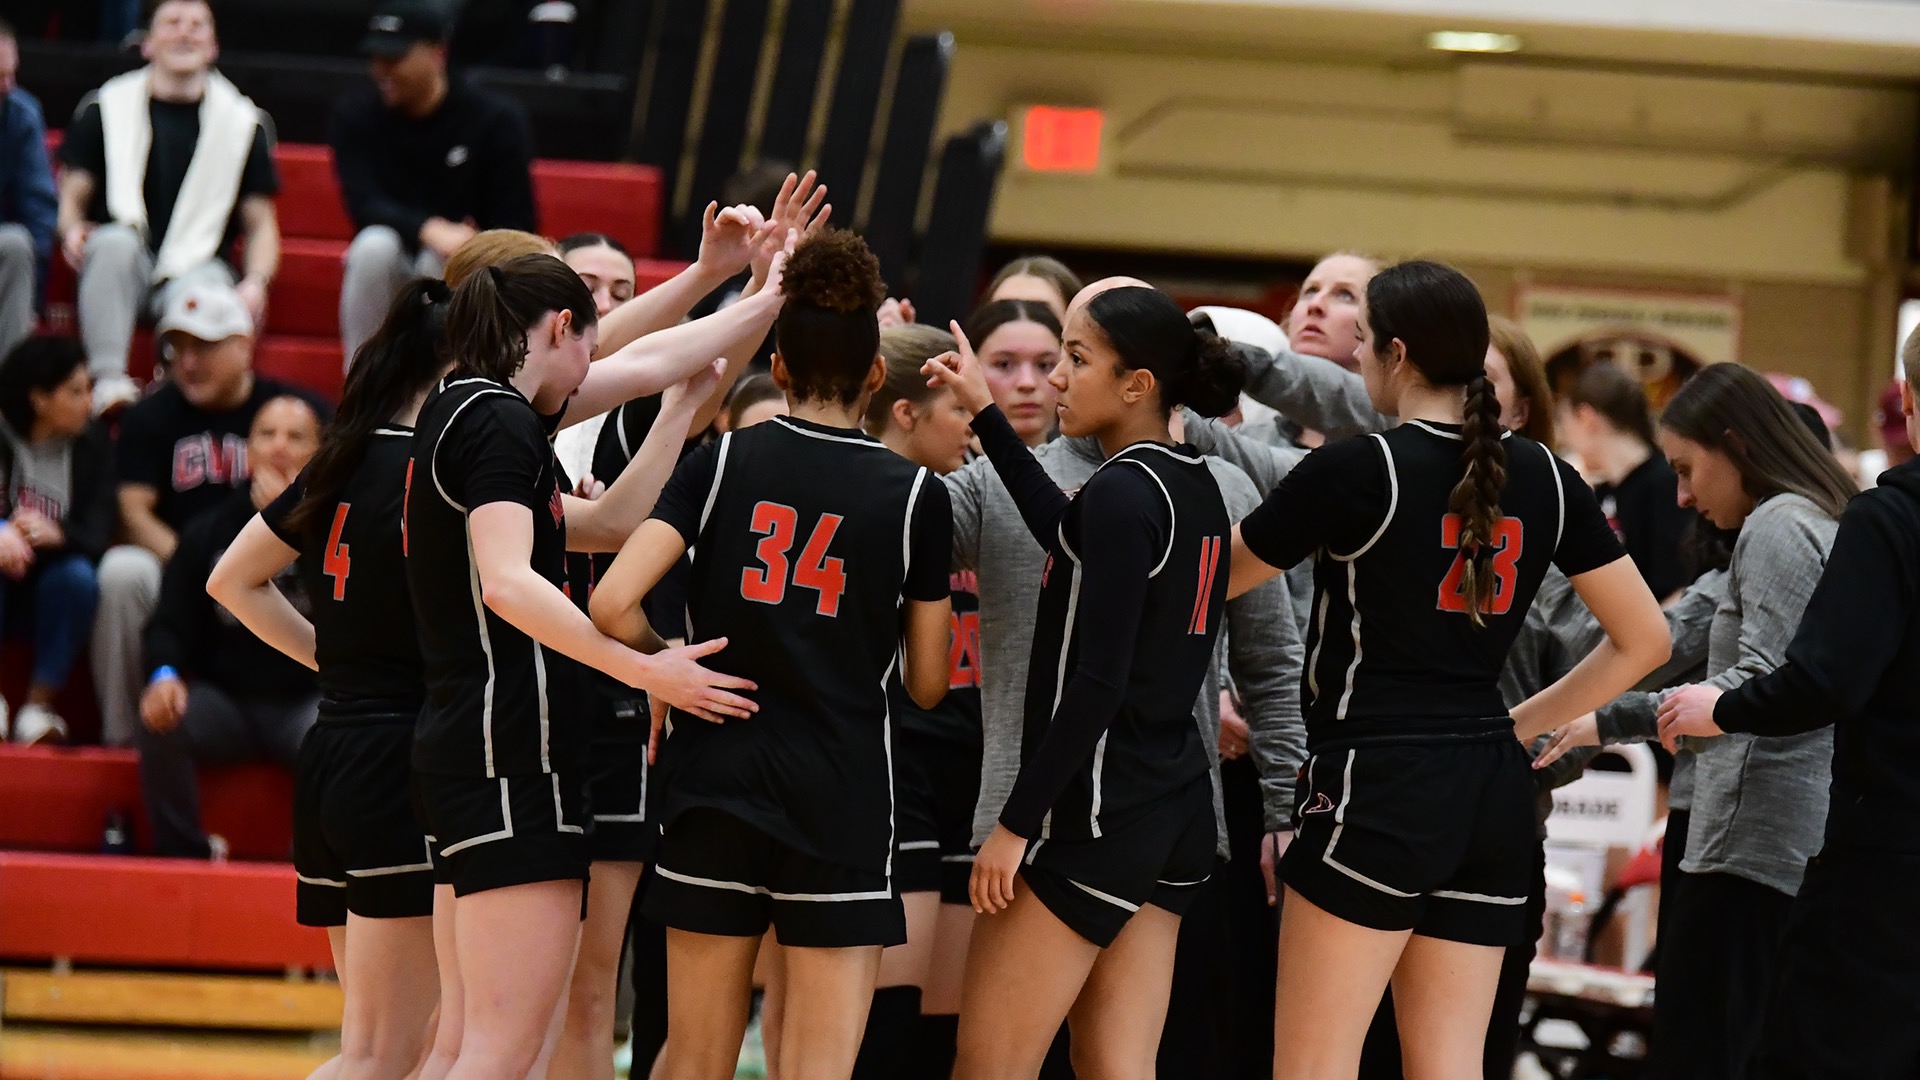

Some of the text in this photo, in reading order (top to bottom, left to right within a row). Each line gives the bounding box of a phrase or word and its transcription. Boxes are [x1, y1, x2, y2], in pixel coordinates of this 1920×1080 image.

[323, 502, 351, 601] 4
[740, 500, 847, 618] 34
[1188, 536, 1221, 635] 11
[1436, 513, 1524, 615] 23
